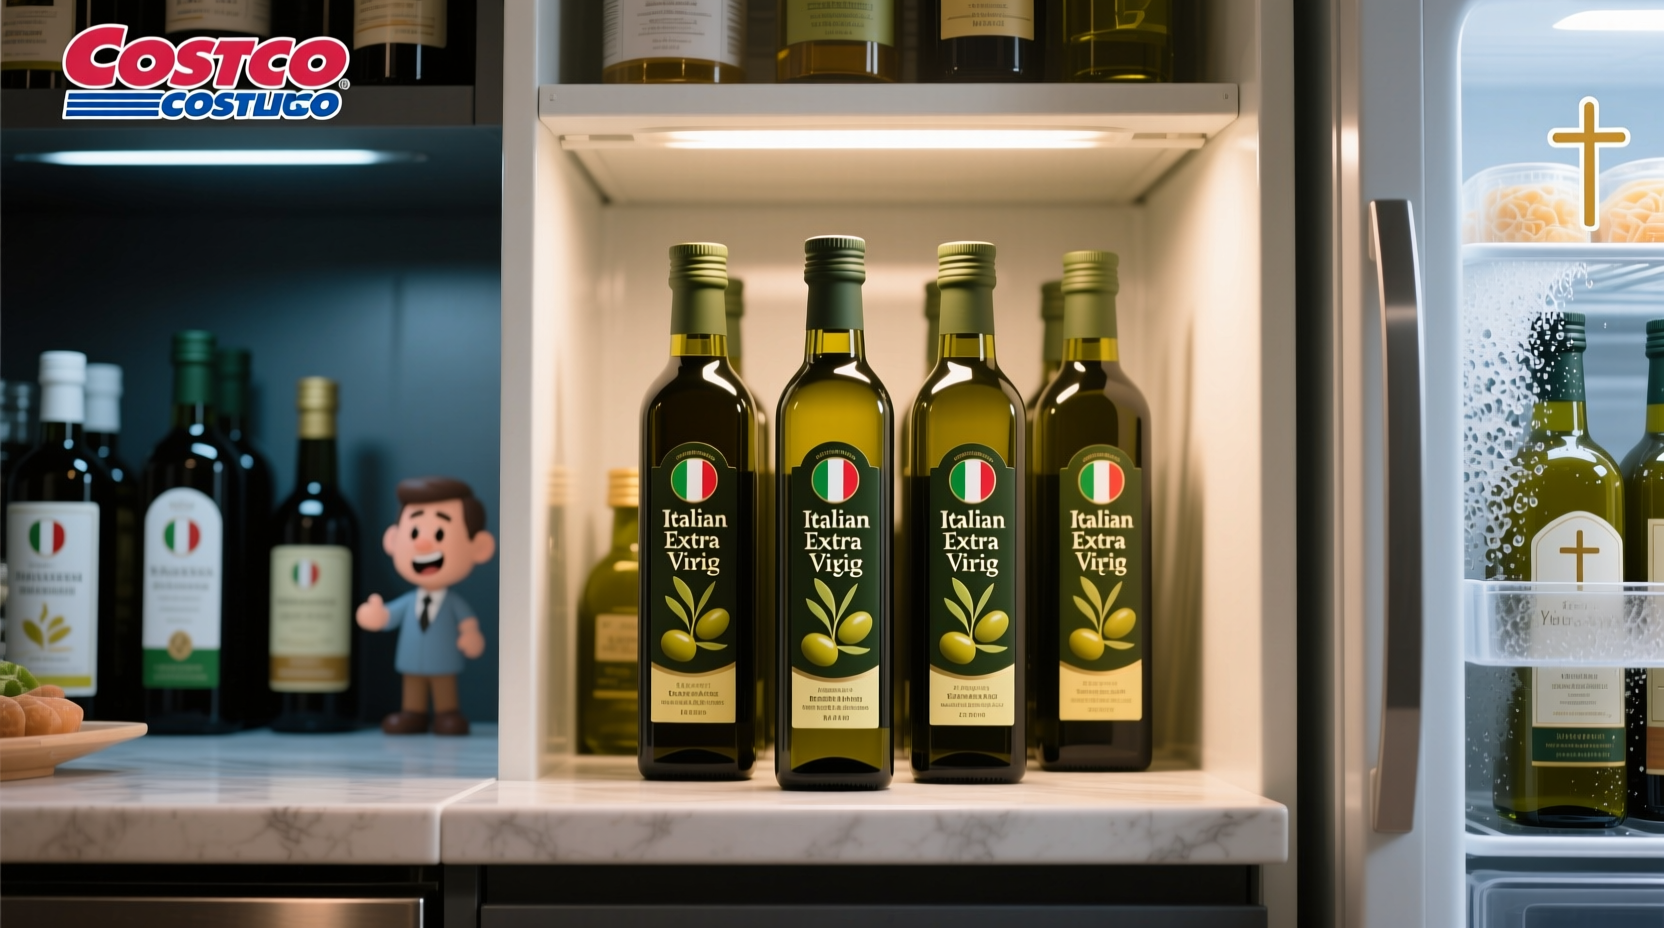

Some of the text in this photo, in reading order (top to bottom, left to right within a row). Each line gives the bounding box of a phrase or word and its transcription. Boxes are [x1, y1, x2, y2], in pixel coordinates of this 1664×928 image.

[662, 508, 728, 528] Italian
[803, 509, 870, 529] Italian
[940, 509, 1006, 529] Italian
[1069, 510, 1134, 529] Italian
[664, 531, 720, 549] Extra
[804, 532, 862, 550] Extra
[943, 531, 999, 550] Extra
[1072, 531, 1126, 549] Extra
[667, 552, 720, 576] Virig
[946, 552, 999, 577] Virig
